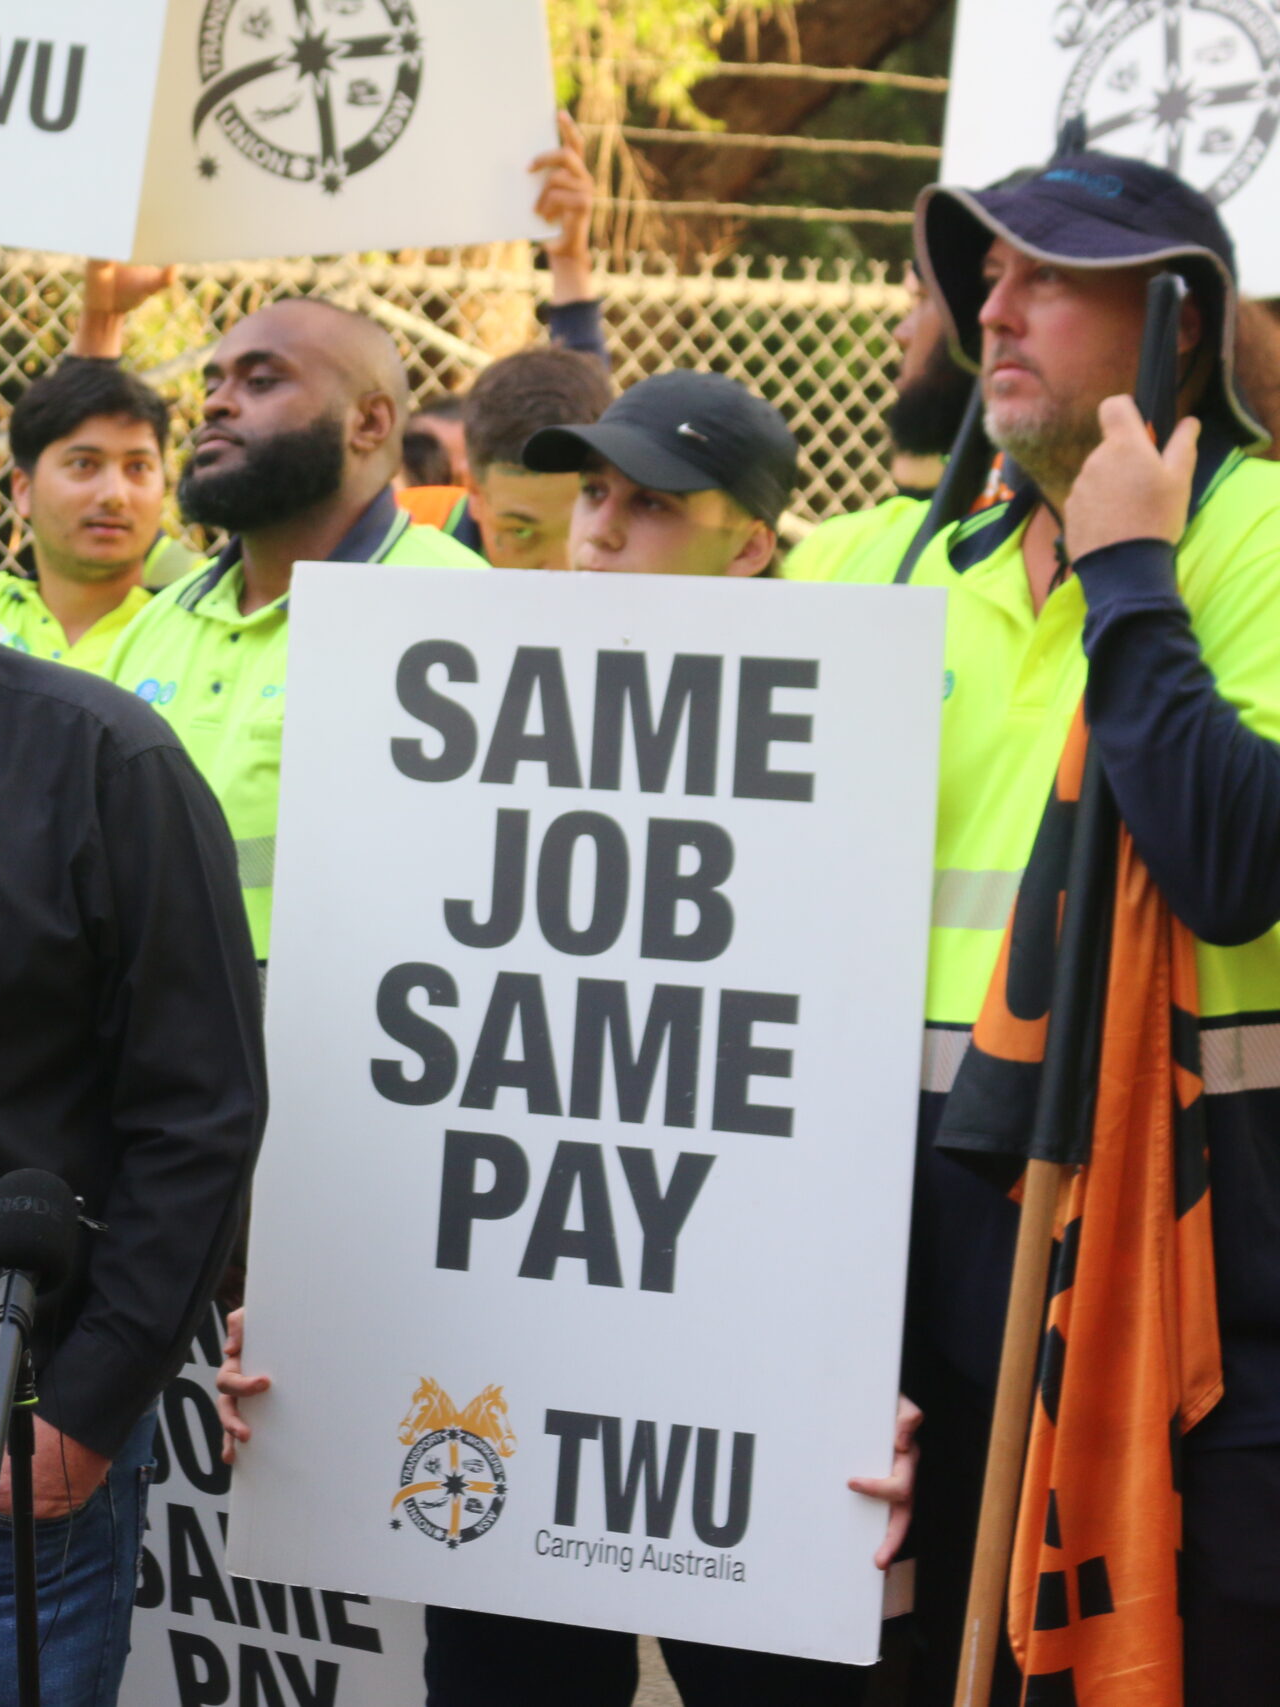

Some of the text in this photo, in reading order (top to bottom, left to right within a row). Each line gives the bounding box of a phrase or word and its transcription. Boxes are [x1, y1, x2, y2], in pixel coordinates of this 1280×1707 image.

[390, 638, 820, 803] SAME
[443, 807, 736, 962] JOB
[370, 960, 800, 1138] SAME
[436, 1128, 718, 1294] PAY
[402, 1433, 443, 1484] TRANSPORT
[406, 1499, 436, 1535] UNION
[544, 1408, 756, 1549] TWU
[535, 1529, 747, 1583] Carrying Australia
